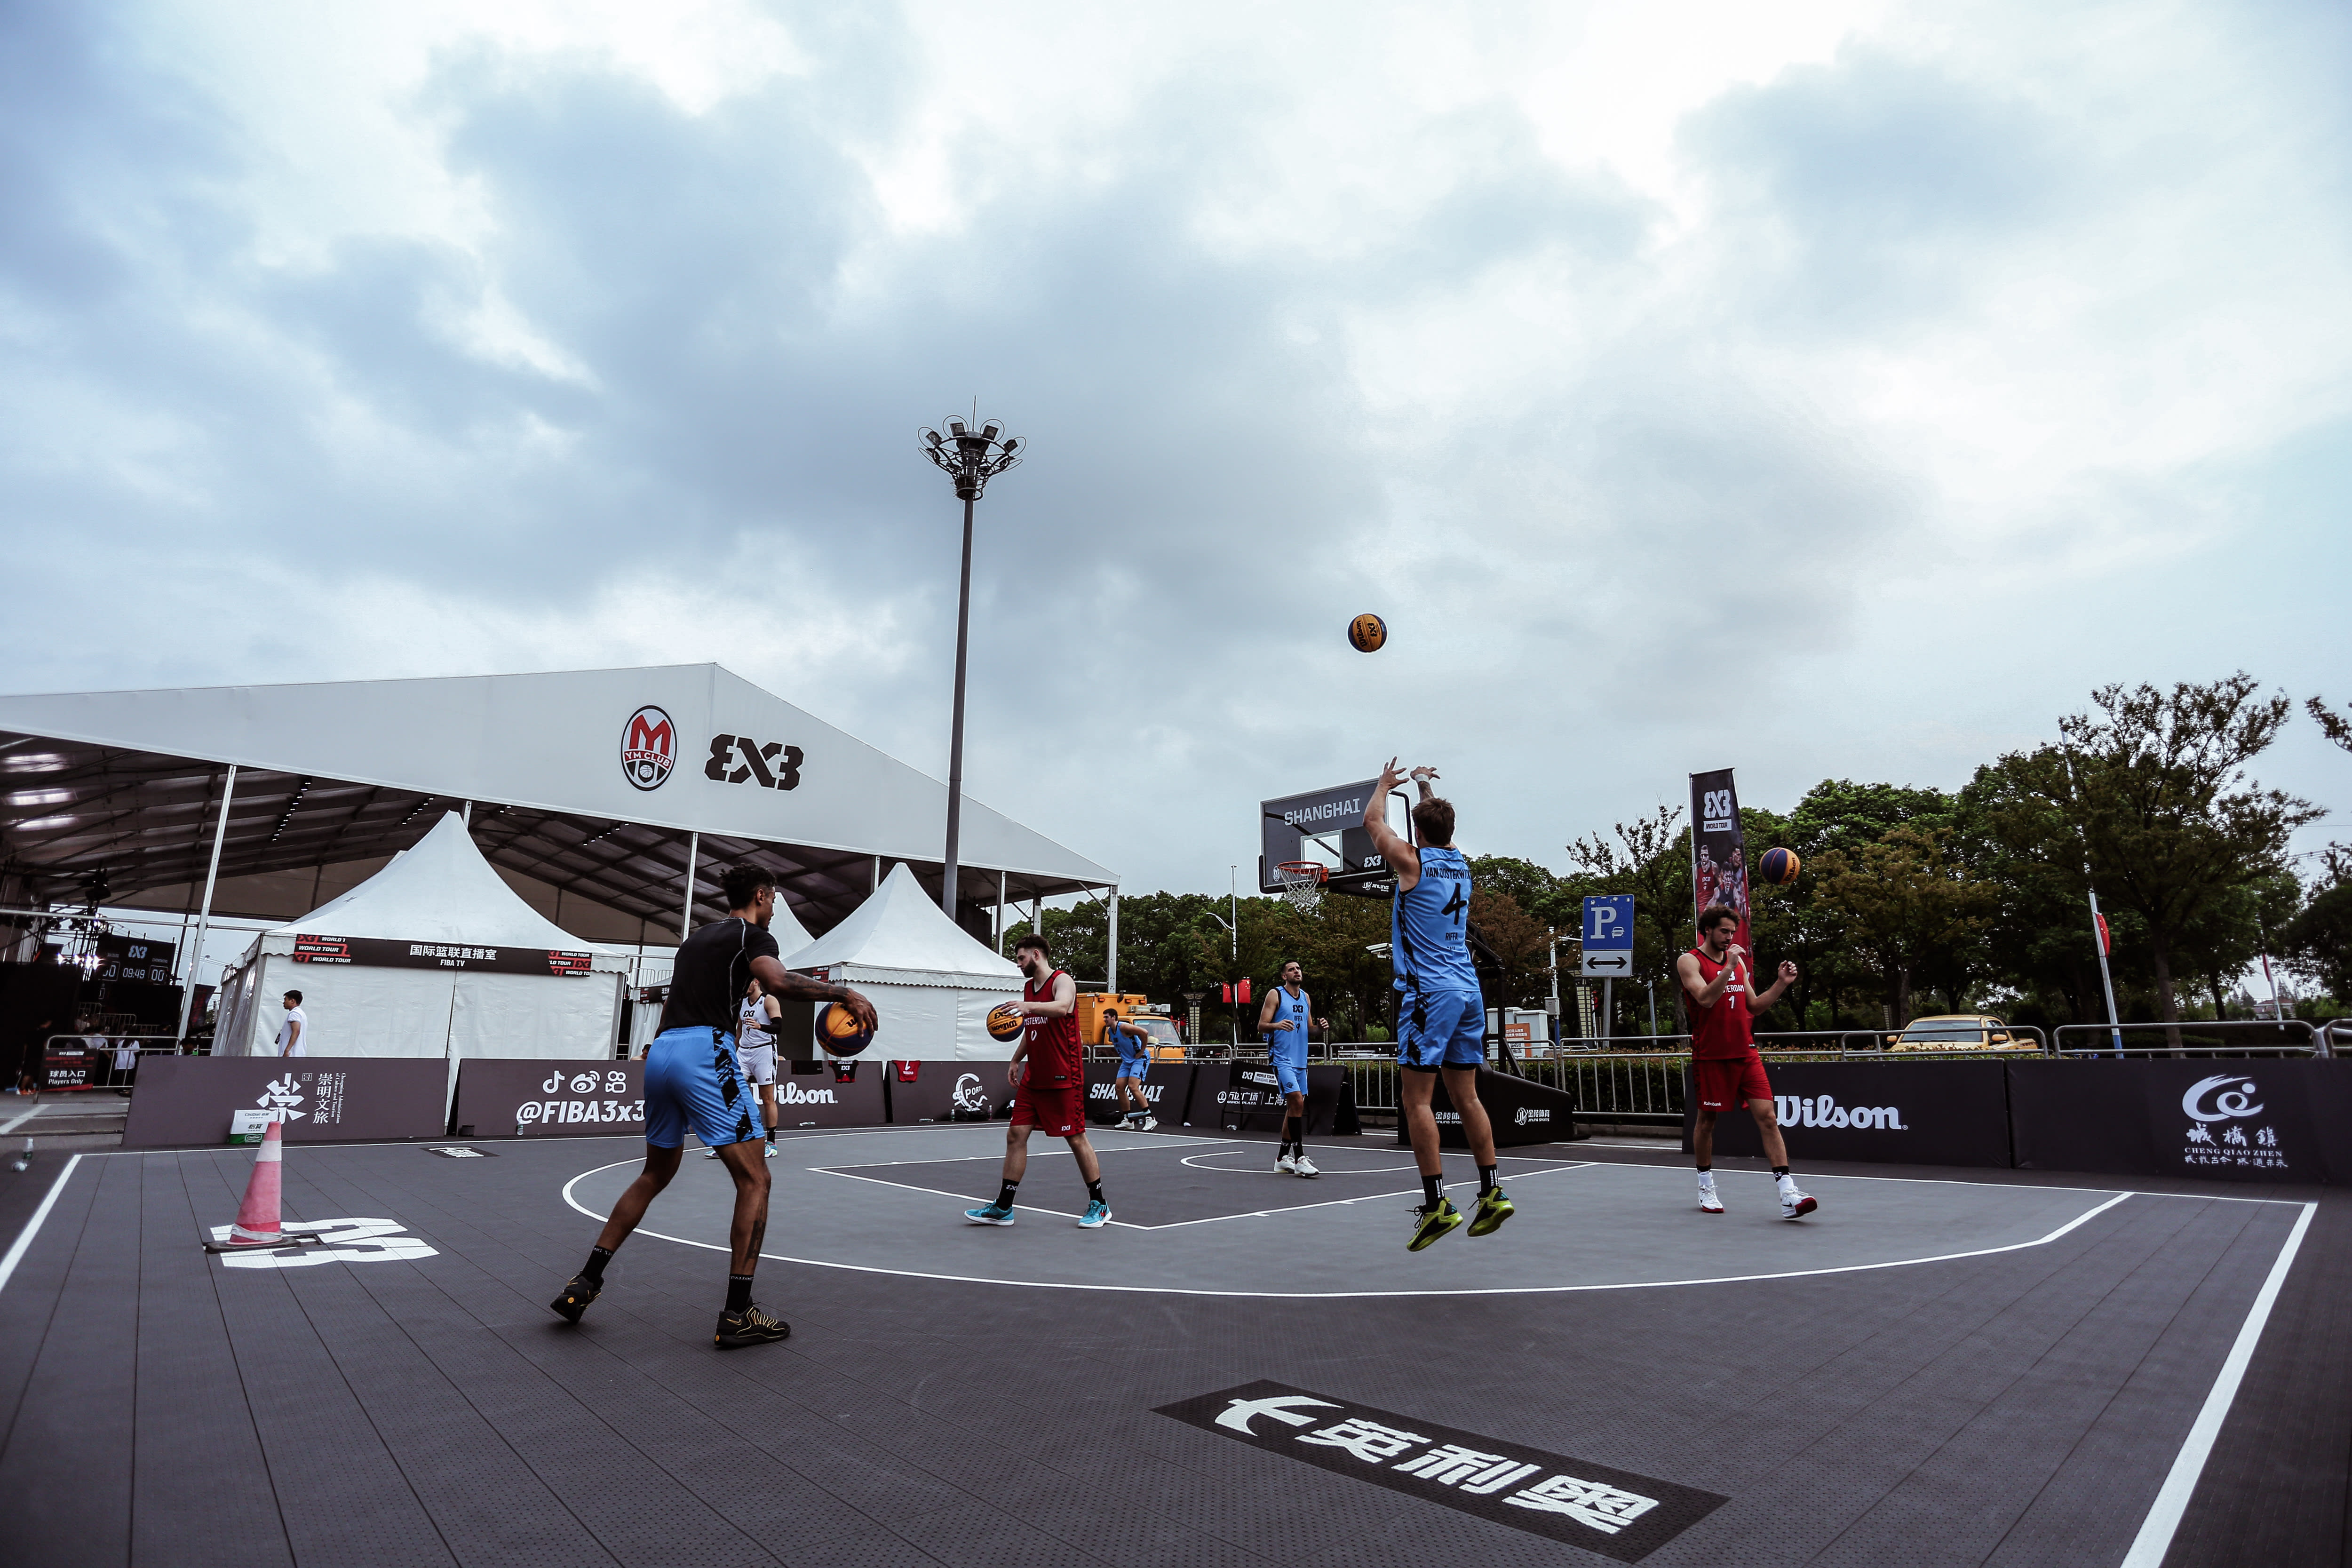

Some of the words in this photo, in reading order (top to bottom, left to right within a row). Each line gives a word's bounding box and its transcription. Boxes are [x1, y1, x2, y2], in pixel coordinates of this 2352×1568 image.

[1356, 620, 1367, 646] Wilson
[644, 752, 670, 767] CLUB
[1284, 798, 1360, 826] SHANGHAI
[1424, 867, 1438, 878] VAN
[1441, 883, 1467, 925] 4
[1590, 907, 1617, 939] P
[1445, 932, 1458, 941] RIFFA
[410, 944, 497, 960] 国际篮联直播室
[123, 968, 145, 979] 09:49
[151, 969, 164, 981] 00
[1729, 995, 1735, 1009] 1
[992, 1020, 1017, 1031] Wilson
[1296, 1023, 1300, 1034] 9
[313, 1073, 333, 1124] 崇明文旅
[1089, 1083, 1164, 1102] SHAGHAI
[1265, 1093, 1287, 1106] 上海
[516, 1100, 645, 1125] @FIBA3x3
[1435, 1112, 1461, 1120] 金陵体
[1528, 1109, 1549, 1118] 金陵体育
[1774, 1095, 1902, 1130] Wilson
[1295, 1417, 1660, 1535] 英利奥
